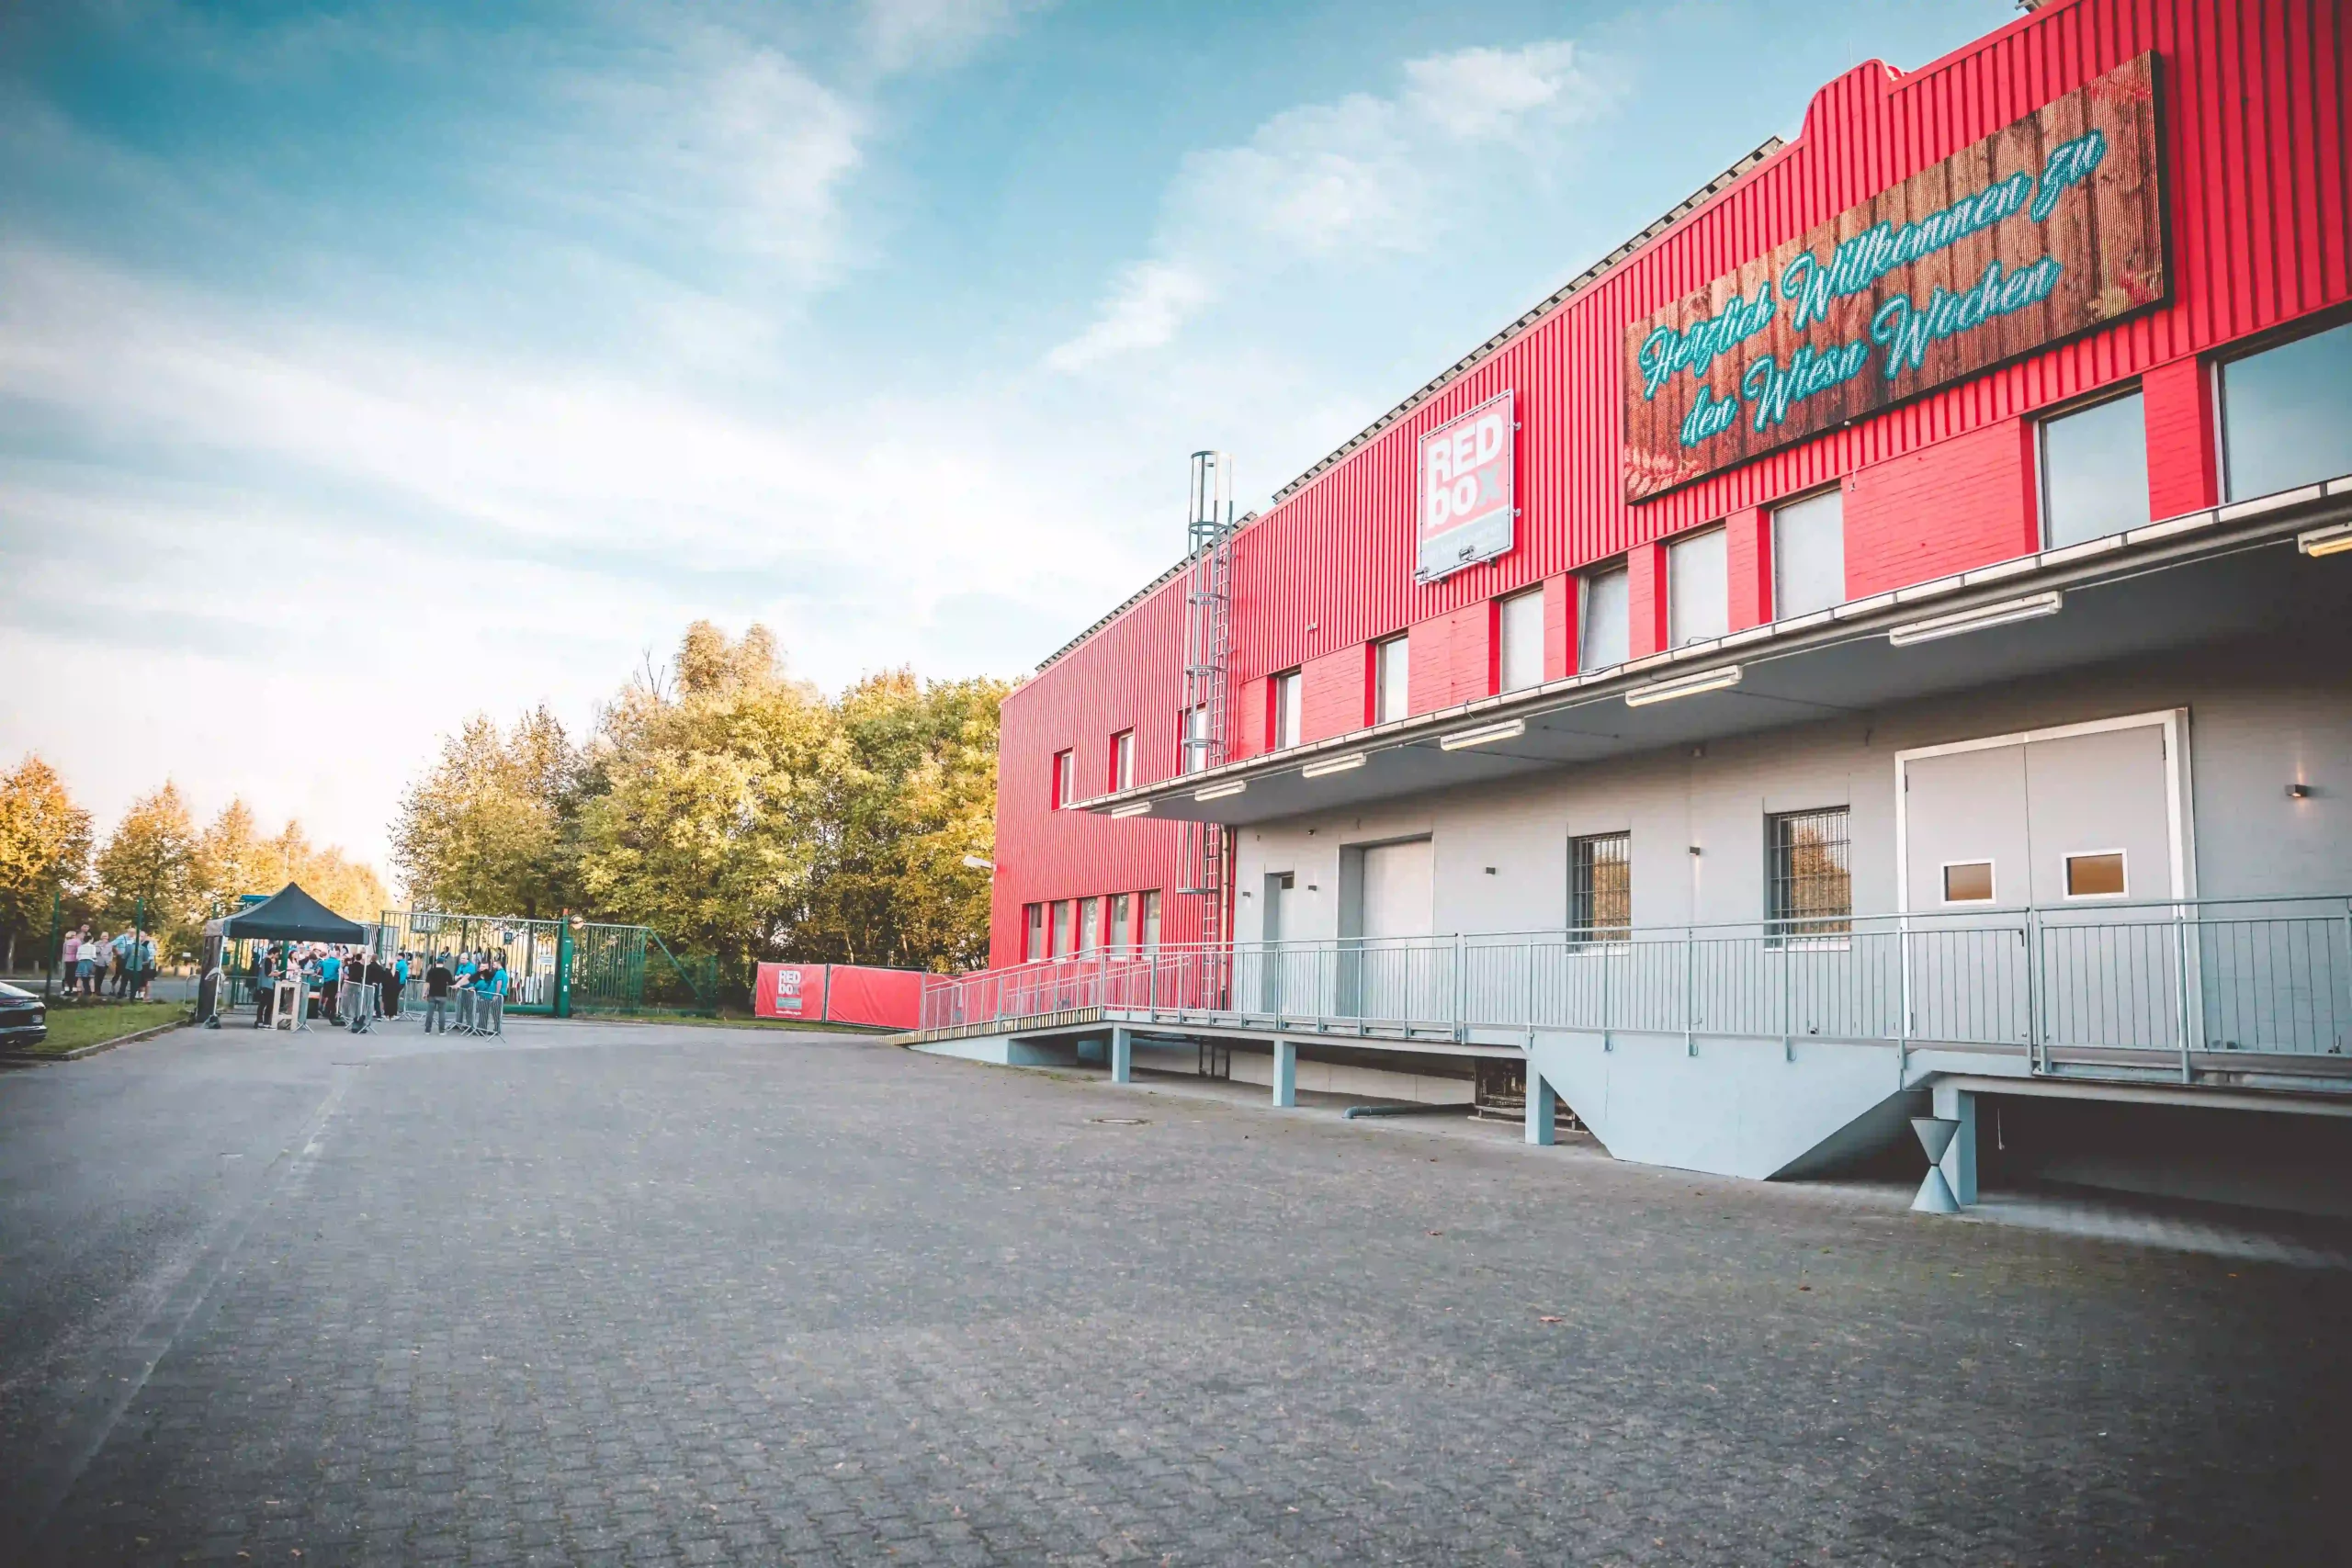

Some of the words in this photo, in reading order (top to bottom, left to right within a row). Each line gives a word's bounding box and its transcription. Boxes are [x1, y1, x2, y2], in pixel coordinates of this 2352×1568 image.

[1639, 280, 1777, 400] Herzlich
[1781, 170, 2034, 333] Willkommen
[2030, 127, 2109, 223] zu
[1679, 384, 1739, 447] den
[1741, 338, 1870, 433] Wiesn
[1869, 254, 2064, 380] Wochen
[1427, 413, 1504, 482] RED
[778, 970, 802, 985] RED
